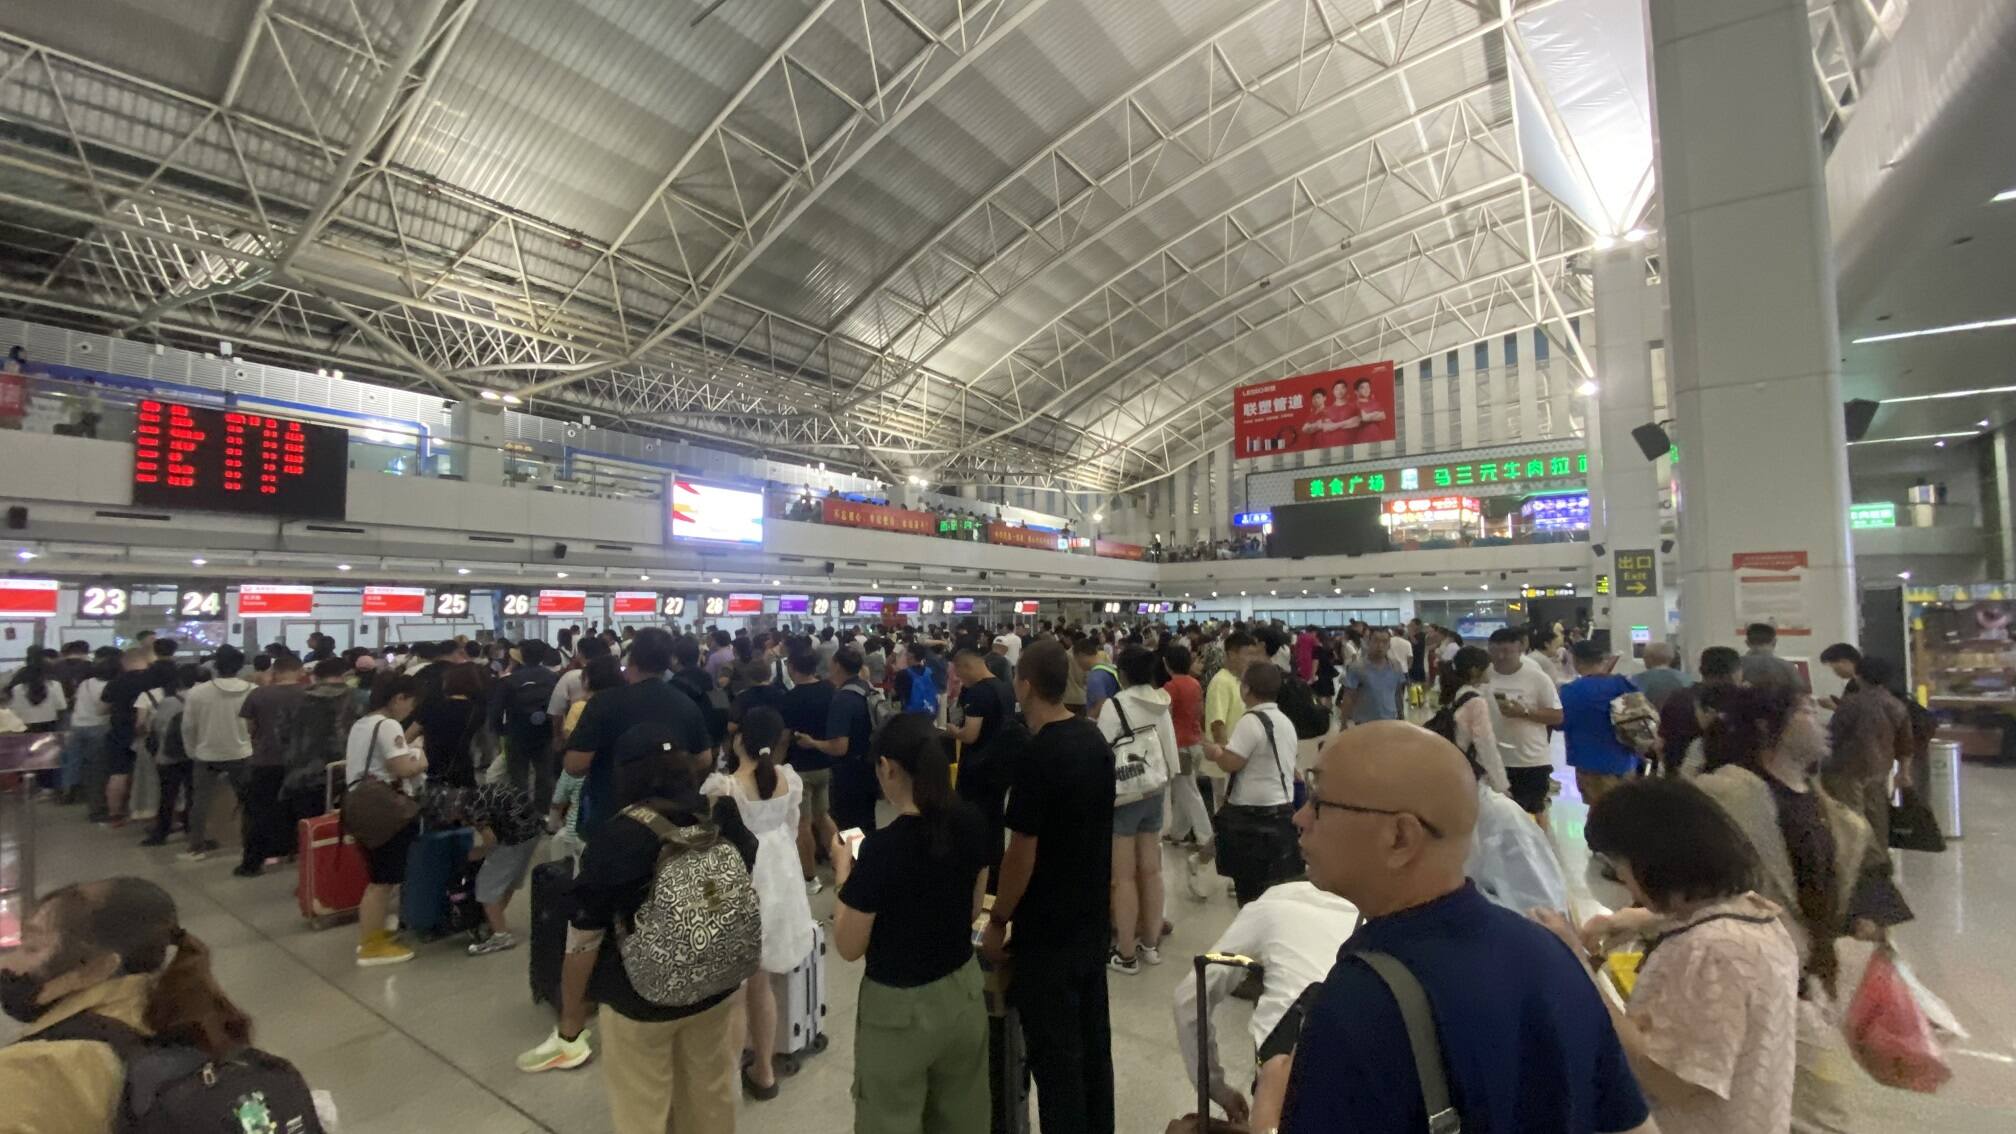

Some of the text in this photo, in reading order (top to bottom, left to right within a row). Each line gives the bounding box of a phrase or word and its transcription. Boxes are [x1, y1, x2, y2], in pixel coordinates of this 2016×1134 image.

[1243, 394, 1303, 416] 联塑管道
[1310, 474, 1385, 497] 美食广场
[1618, 556, 1651, 569] 出口
[1624, 572, 1647, 580] Exit
[82, 587, 126, 615] 23
[181, 591, 220, 616] 24
[437, 593, 466, 614] 25
[503, 594, 528, 615] 26
[664, 597, 684, 615] 27
[705, 597, 723, 615] 28
[814, 598, 829, 614] 29
